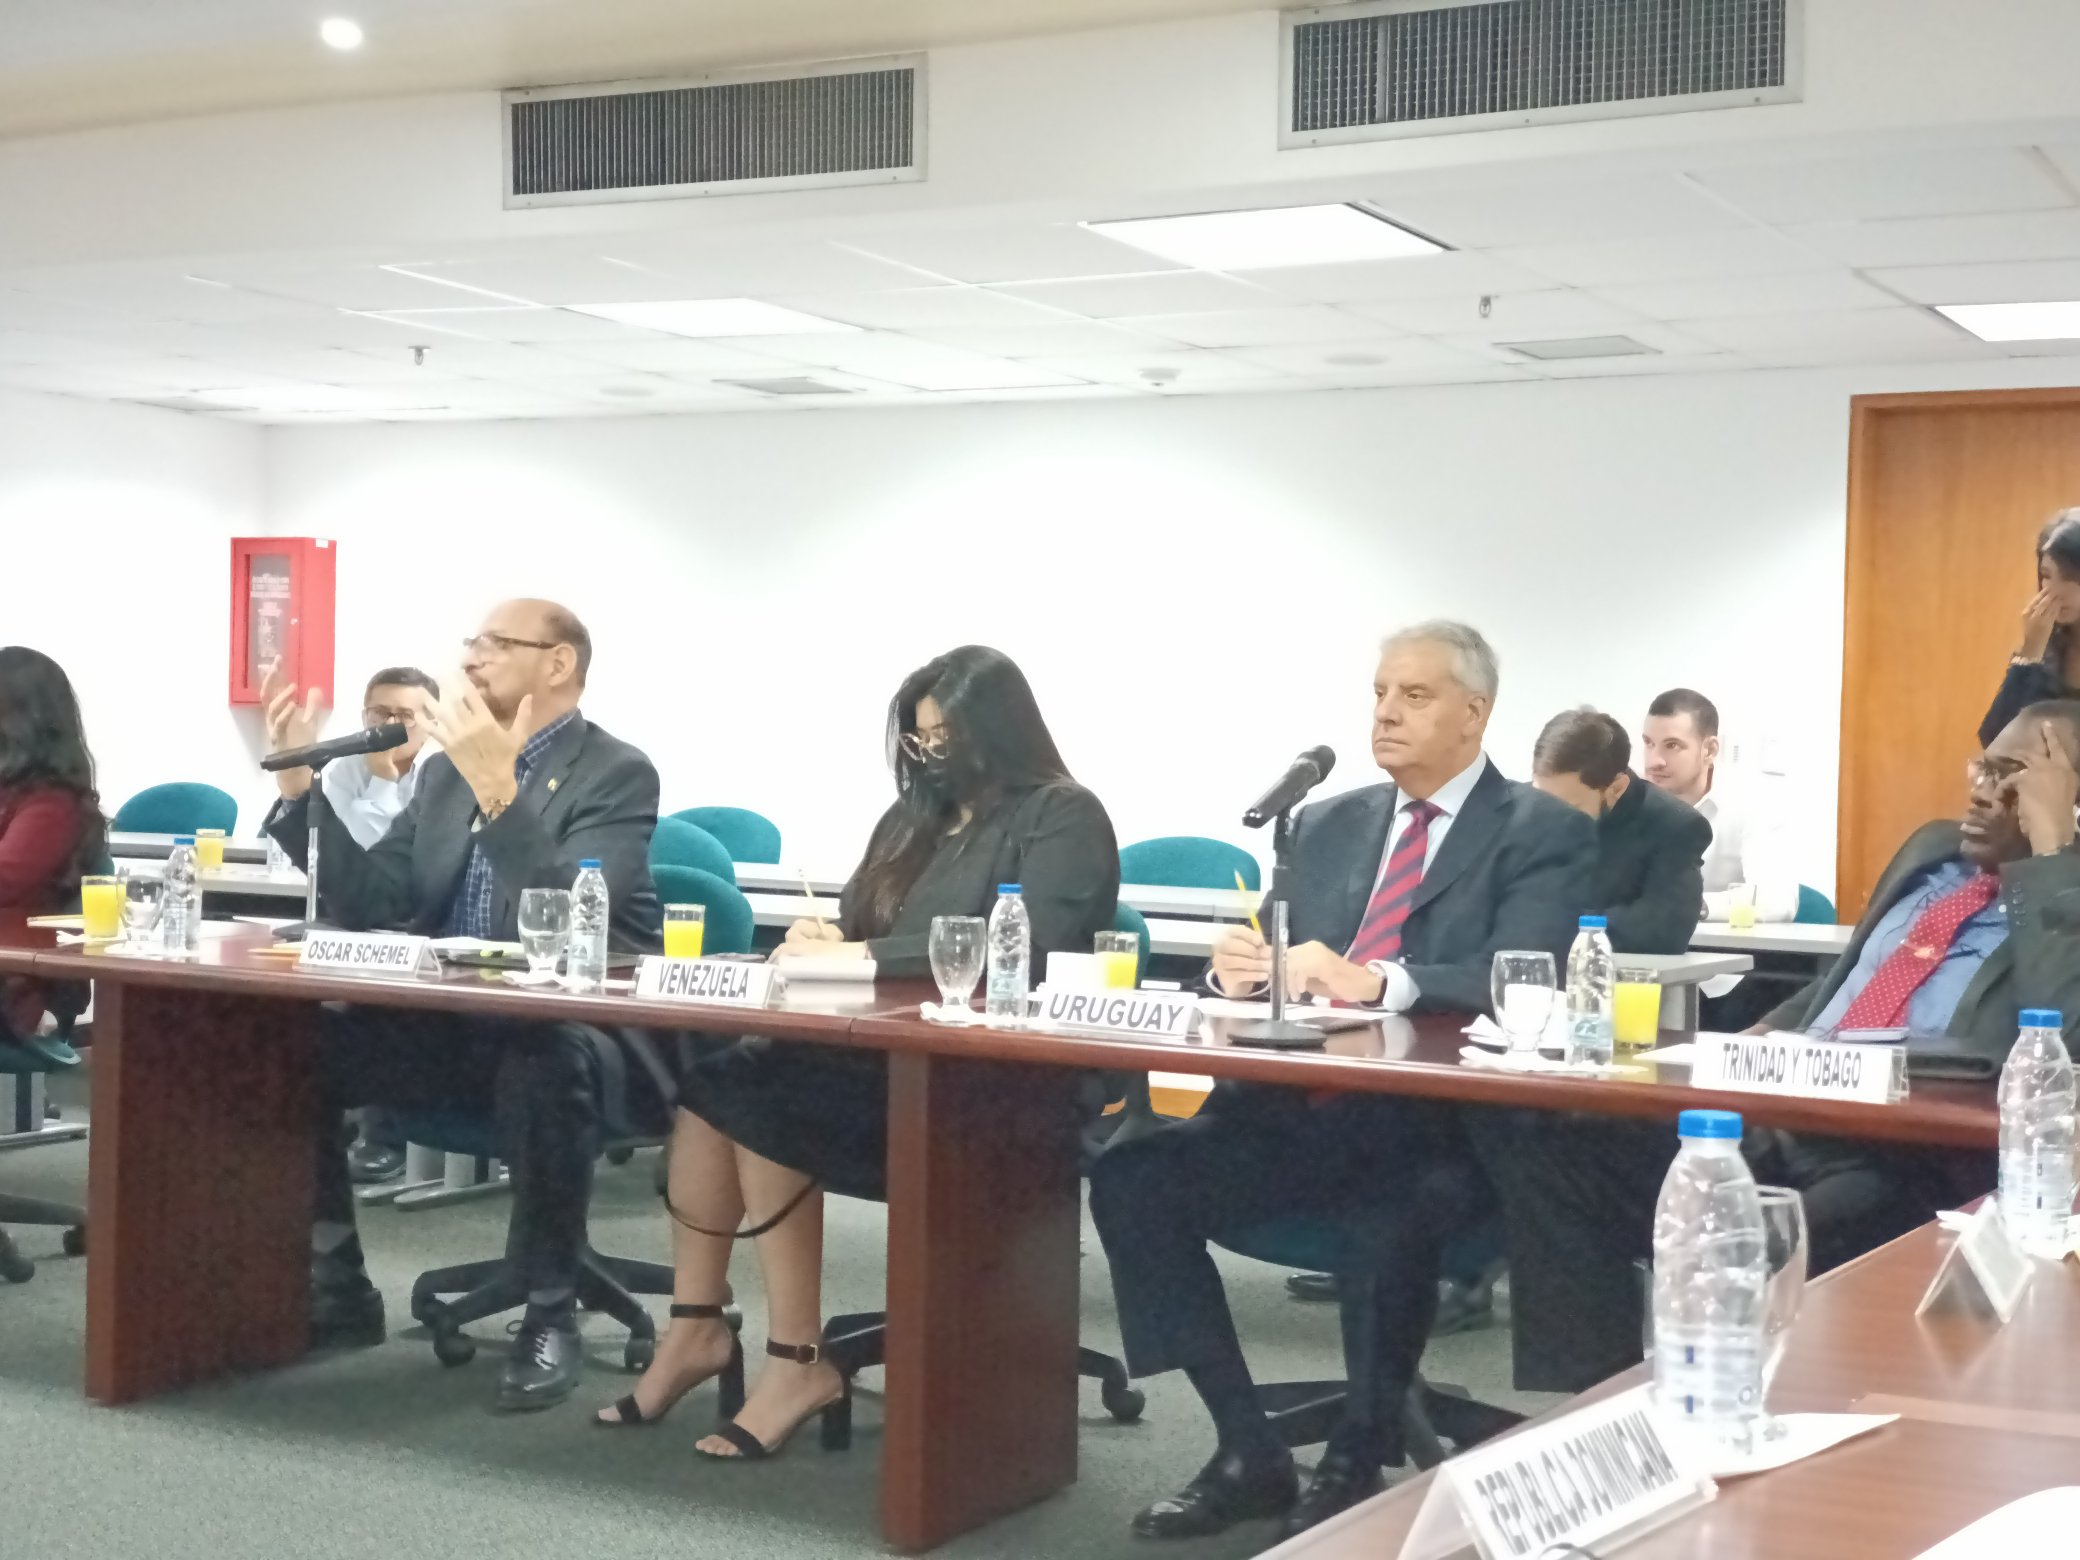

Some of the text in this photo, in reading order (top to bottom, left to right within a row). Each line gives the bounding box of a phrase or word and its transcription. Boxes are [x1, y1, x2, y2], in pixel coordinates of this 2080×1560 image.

[308, 940, 411, 965] OSCAR SCHEMEL
[658, 963, 749, 998] VENEZUELA
[1049, 993, 1184, 1031] URUGUAY
[1722, 1043, 1862, 1089] TRINIDAD Y TOBAGO
